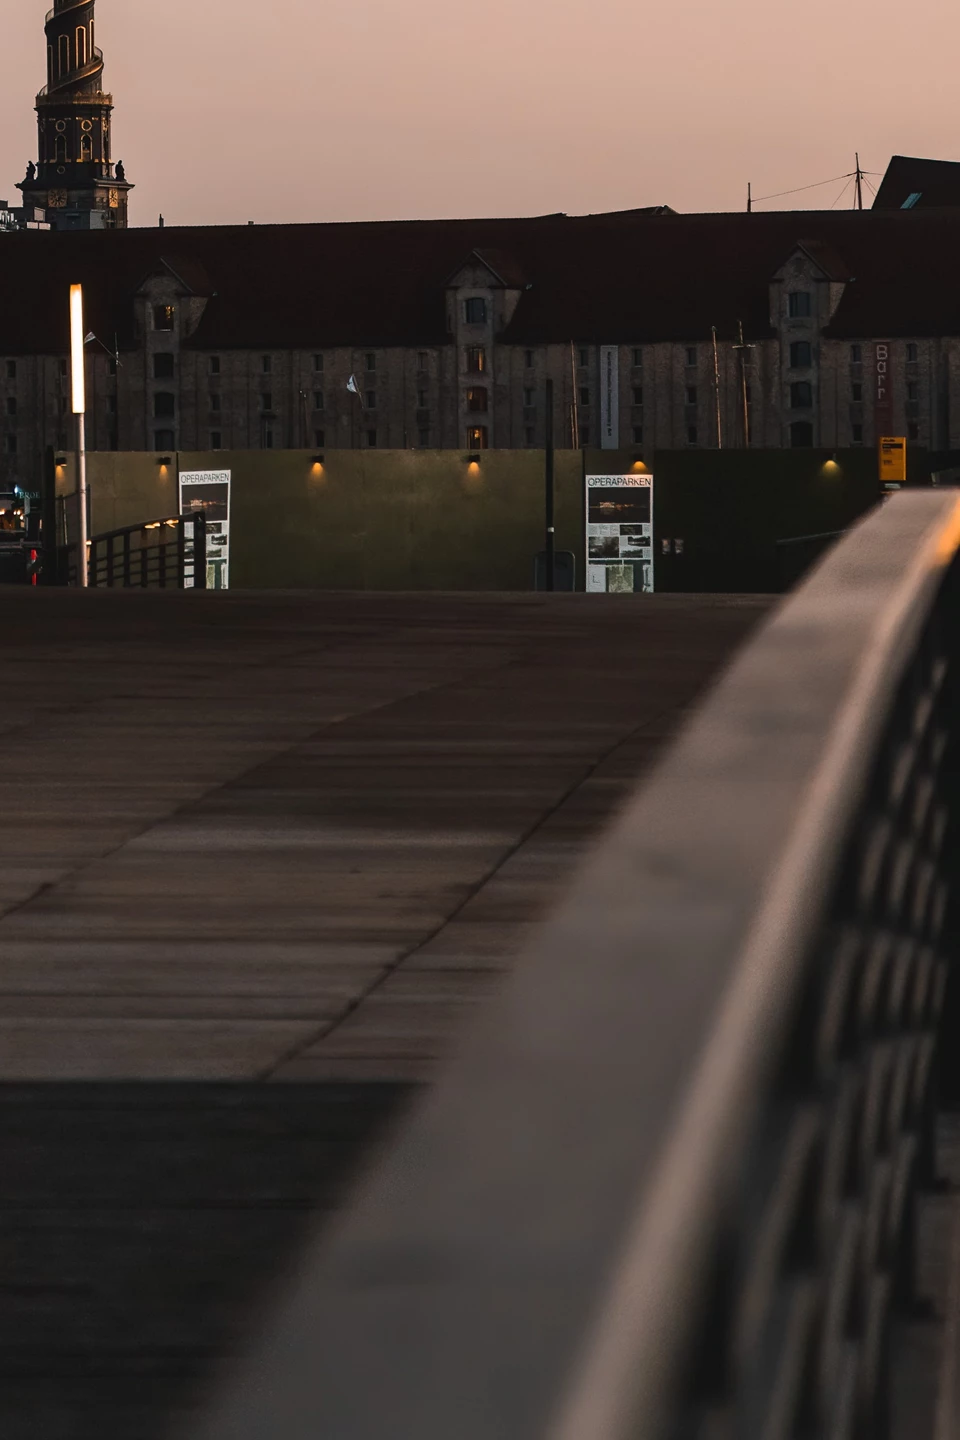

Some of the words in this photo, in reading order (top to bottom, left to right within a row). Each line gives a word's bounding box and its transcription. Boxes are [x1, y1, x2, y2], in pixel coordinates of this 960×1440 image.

[876, 345, 888, 399] Barr
[181, 473, 229, 484] OPERAPARKEN
[588, 477, 652, 487] OPERAPARKEN
